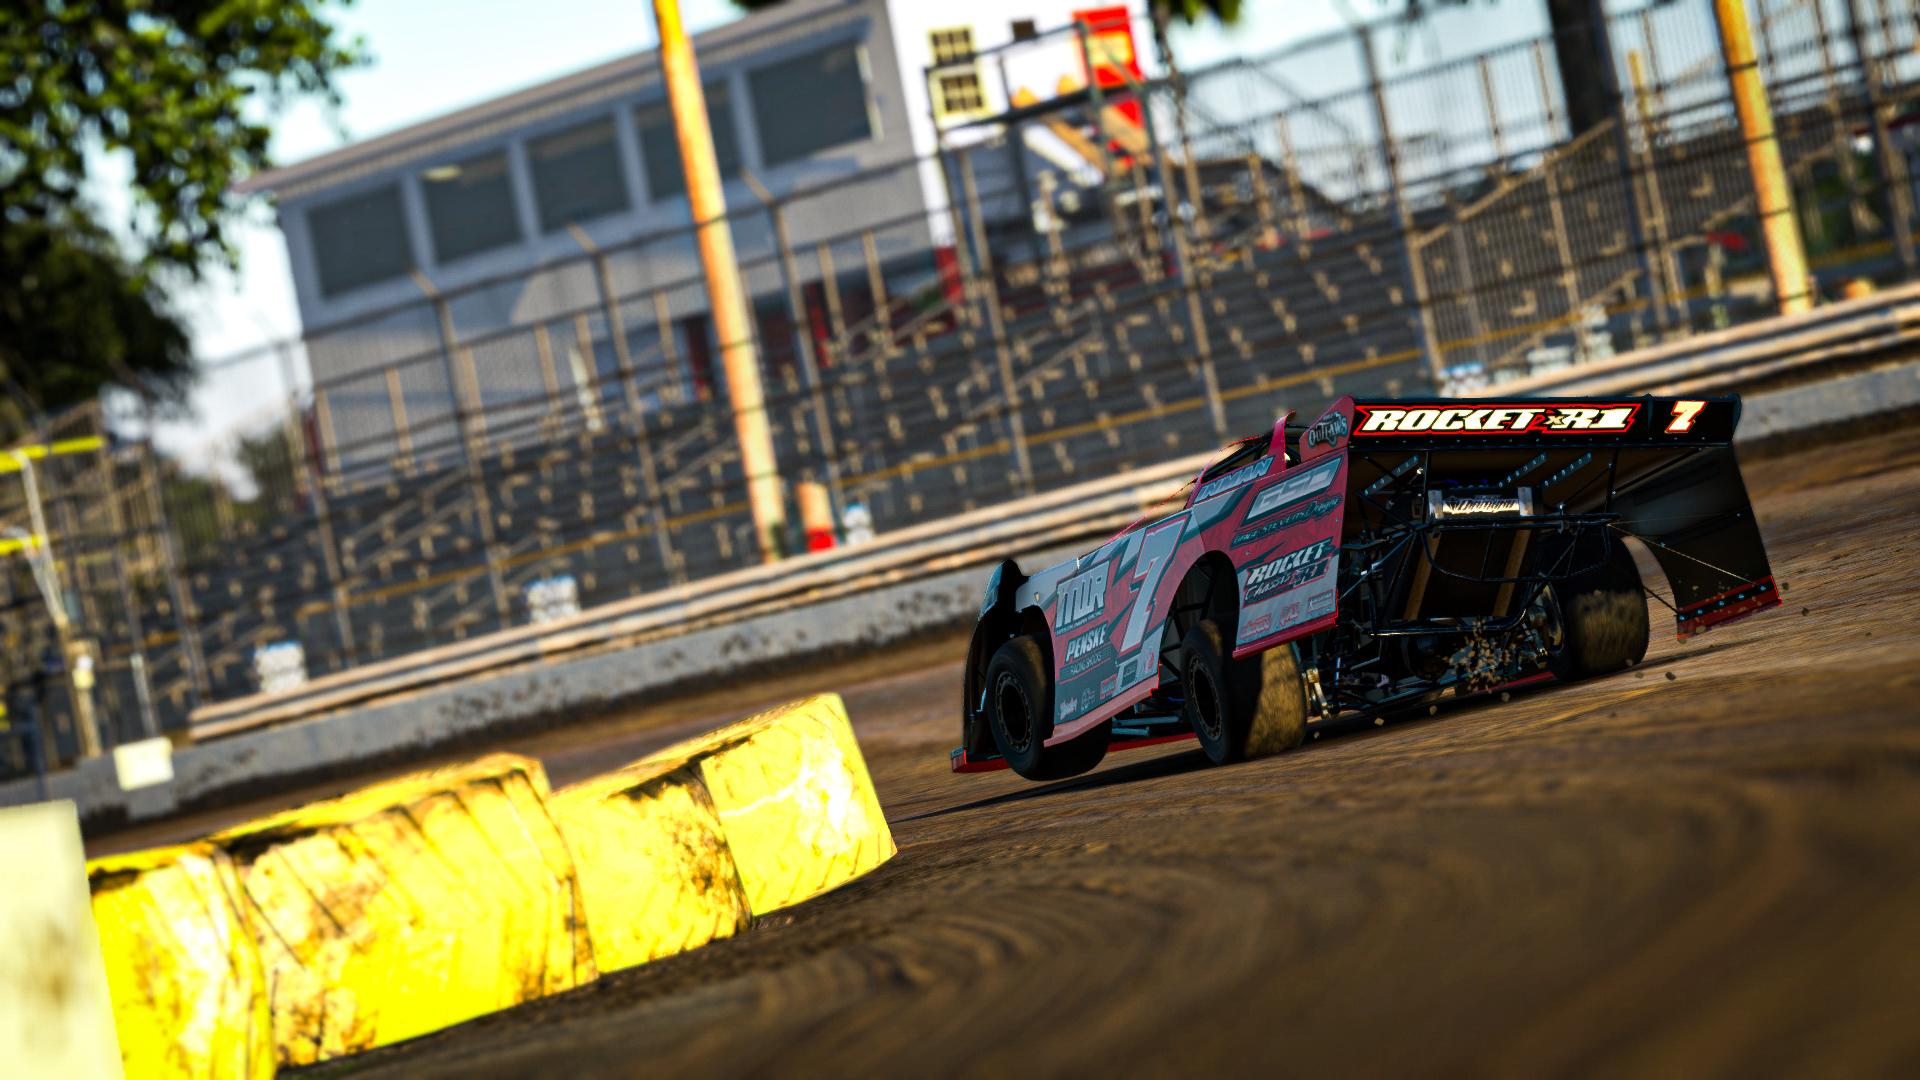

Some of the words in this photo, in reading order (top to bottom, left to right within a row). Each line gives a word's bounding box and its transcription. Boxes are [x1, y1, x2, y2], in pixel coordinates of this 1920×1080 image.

[1309, 416, 1348, 447] OUTLAWS
[1361, 408, 1545, 431] ROCKET
[1665, 400, 1705, 433] 7
[1194, 455, 1275, 503] INMAN
[1247, 540, 1329, 586] ROCKET
[1119, 514, 1188, 656] 7
[1065, 623, 1107, 663] PENSKE
